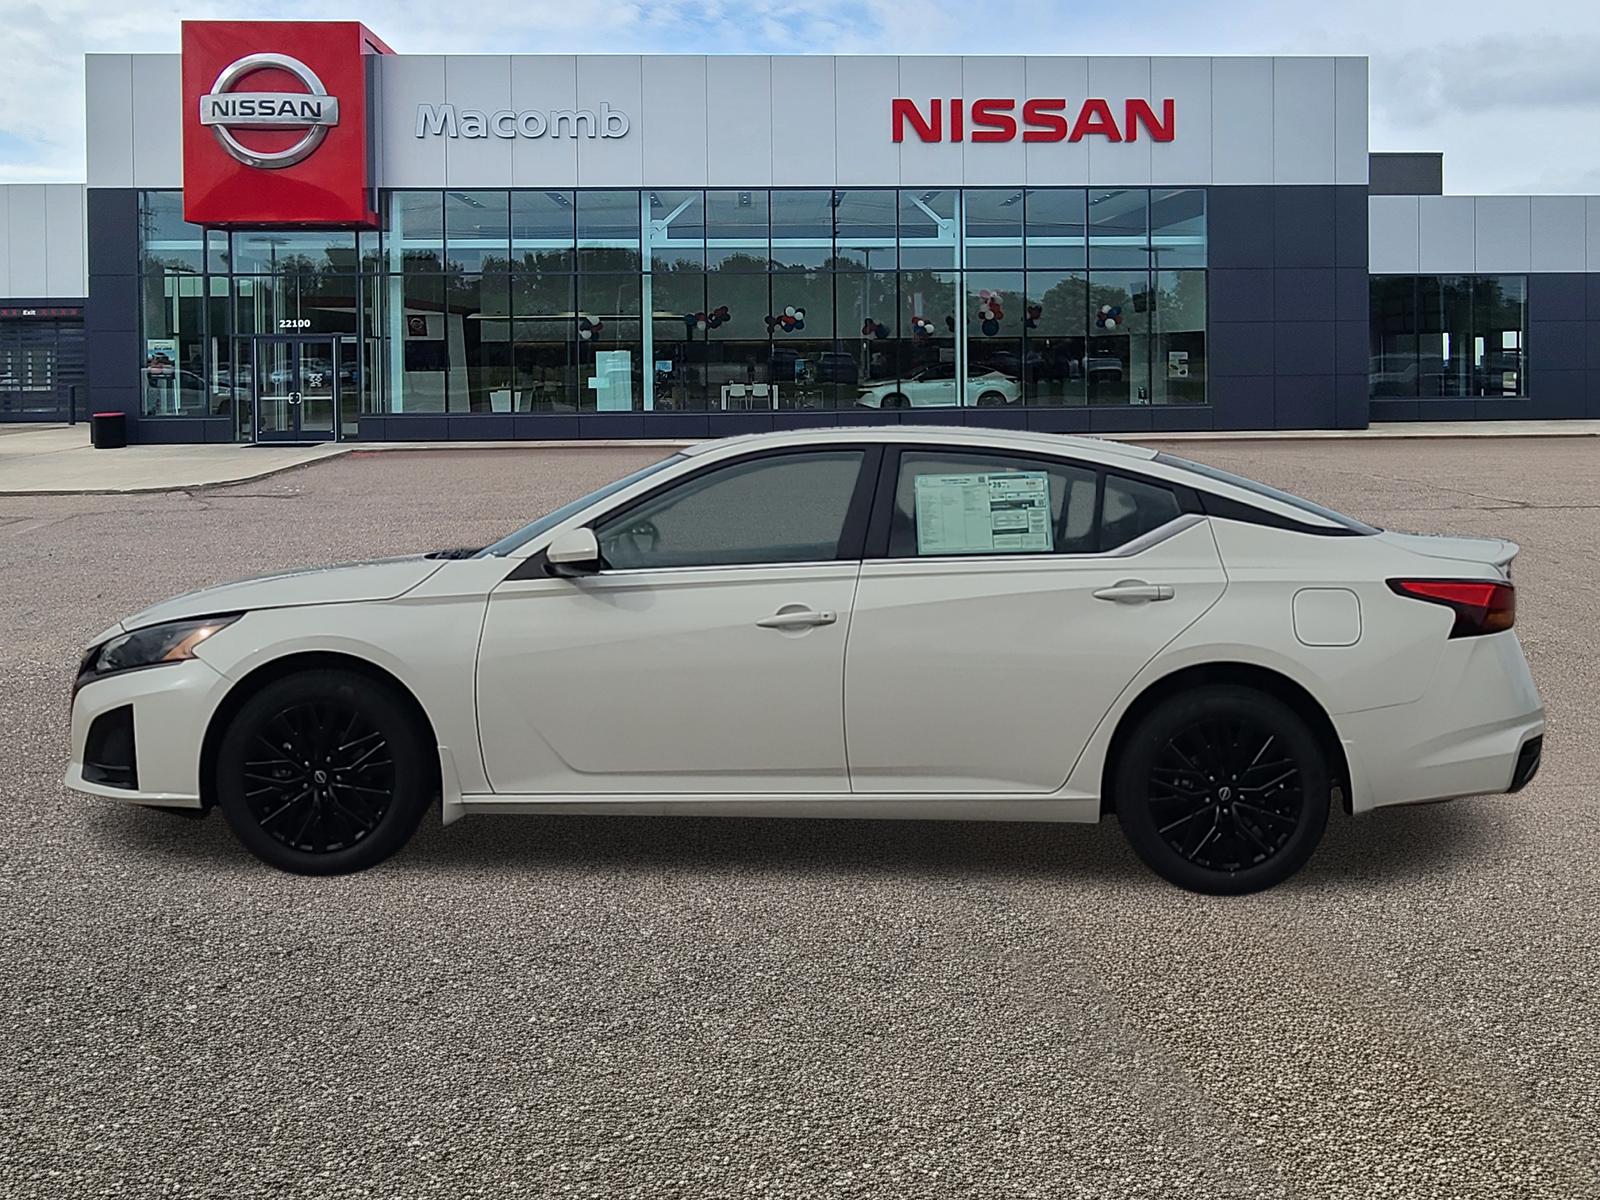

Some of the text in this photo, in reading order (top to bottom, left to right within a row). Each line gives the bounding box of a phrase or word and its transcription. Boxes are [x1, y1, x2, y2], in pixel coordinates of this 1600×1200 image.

[211, 99, 322, 118] NISSAN
[415, 101, 630, 138] Macomb
[891, 98, 1176, 143] NISSAN
[279, 319, 311, 328] 22100
